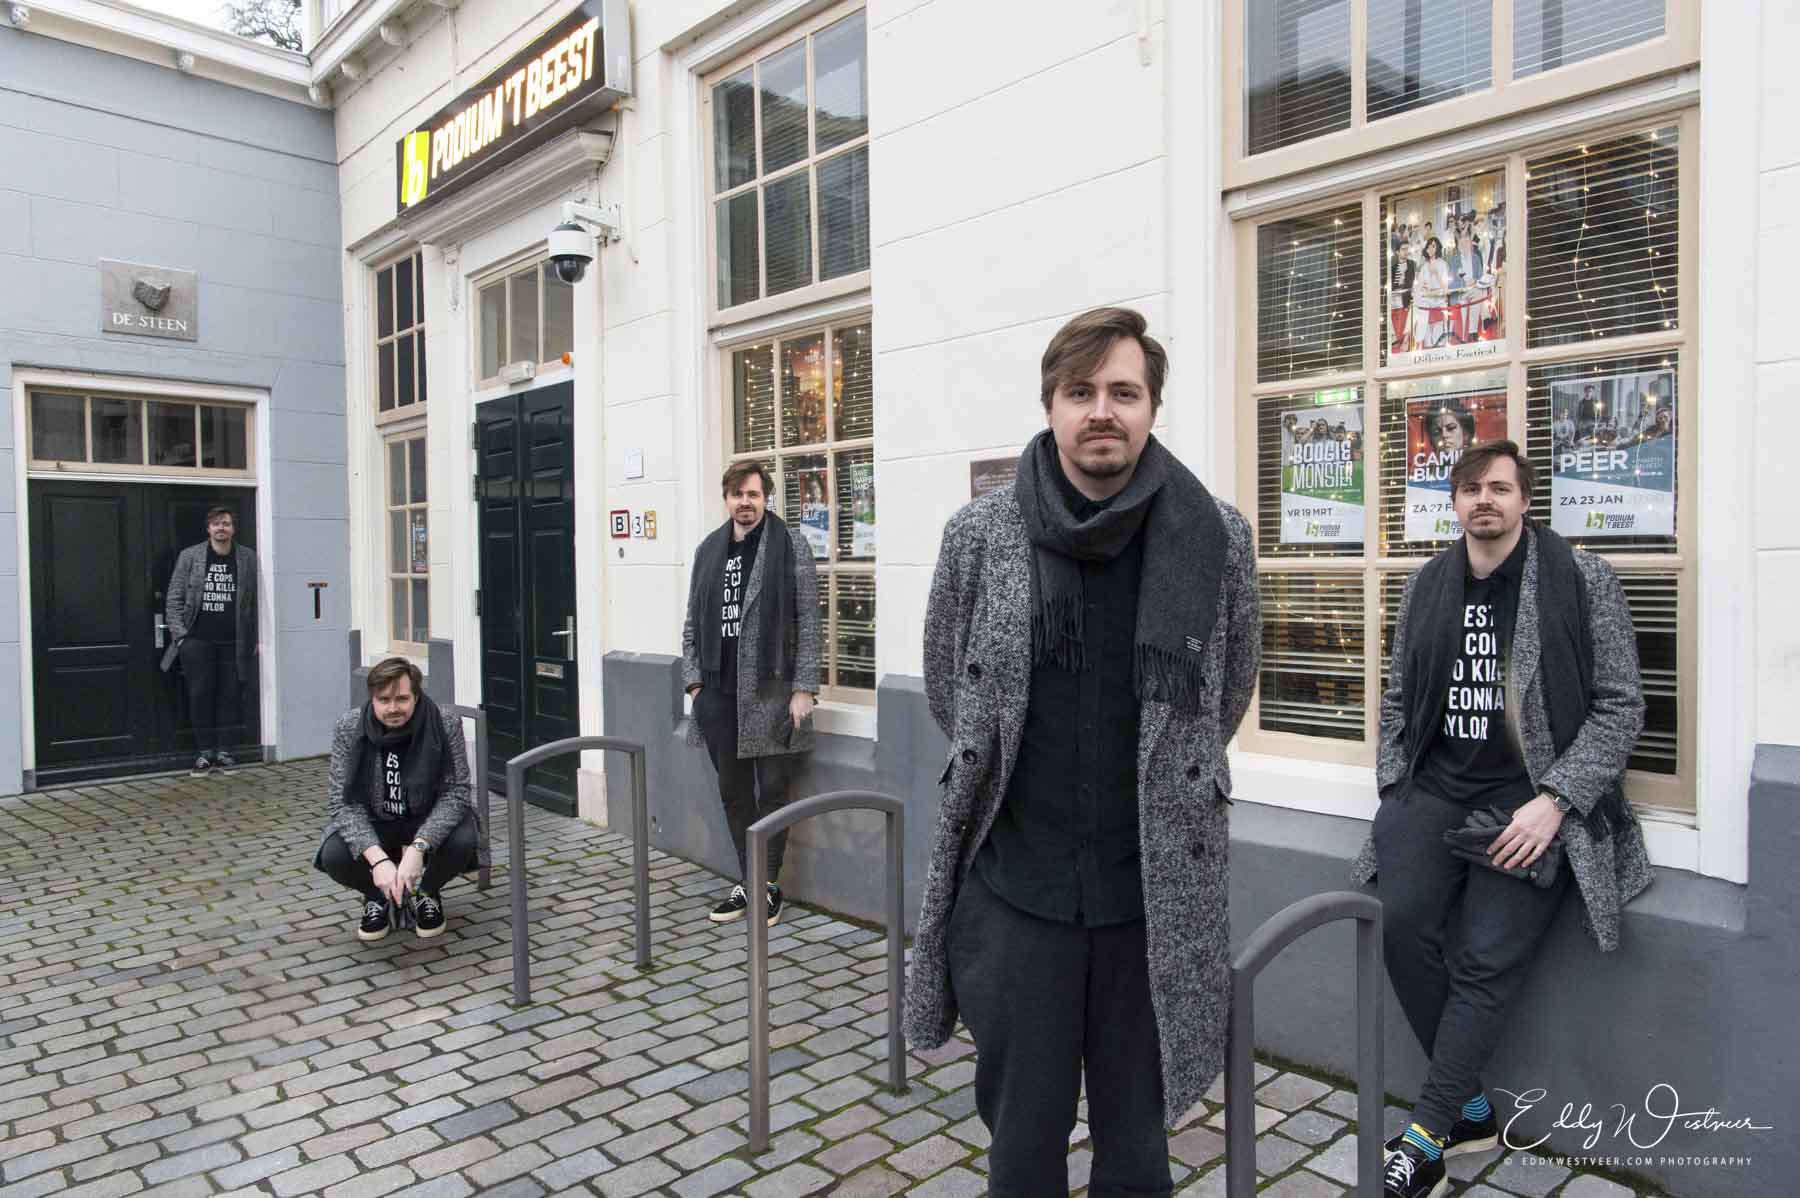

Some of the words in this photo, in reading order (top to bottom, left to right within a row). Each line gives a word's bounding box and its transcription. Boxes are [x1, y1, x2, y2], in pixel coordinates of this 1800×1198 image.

[432, 84, 503, 179] PODIUM
[525, 16, 599, 118] BEEST
[112, 312, 135, 326] DE
[139, 315, 187, 332] STEEN
[1293, 440, 1351, 464] BOOGIE
[1560, 450, 1629, 473] PEER
[1292, 461, 1353, 489] MONSTER
[1413, 504, 1428, 513] ZA
[1560, 496, 1577, 506] ZA
[1580, 495, 1595, 505] 23
[1597, 494, 1624, 504] JAN
[1288, 509, 1300, 517] VR
[1313, 507, 1332, 517] MRT
[616, 516, 624, 532] B
